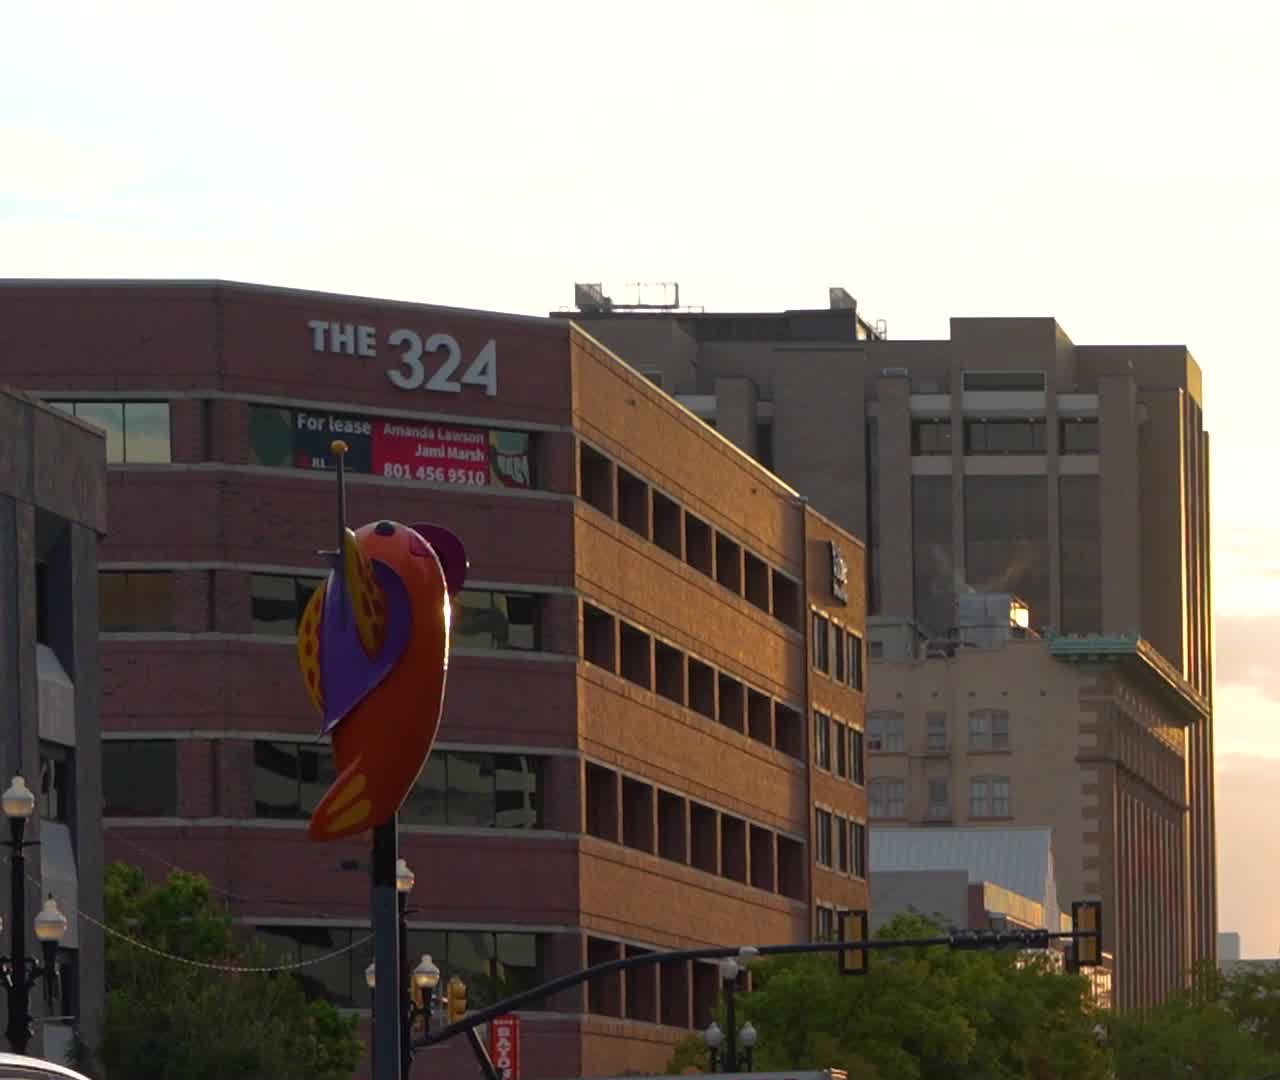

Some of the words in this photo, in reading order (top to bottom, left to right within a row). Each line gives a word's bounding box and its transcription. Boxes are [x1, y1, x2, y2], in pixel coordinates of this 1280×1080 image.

[307, 319, 377, 357] THE
[386, 328, 498, 396] 324
[296, 412, 326, 432] For
[328, 414, 372, 436] lease
[383, 422, 435, 441] Amanda
[437, 427, 485, 445] Lawson
[415, 444, 445, 458] Jami
[447, 446, 485, 463] Marsh
[383, 462, 412, 480] 801
[415, 466, 445, 481] 456
[447, 468, 486, 486] 9510
